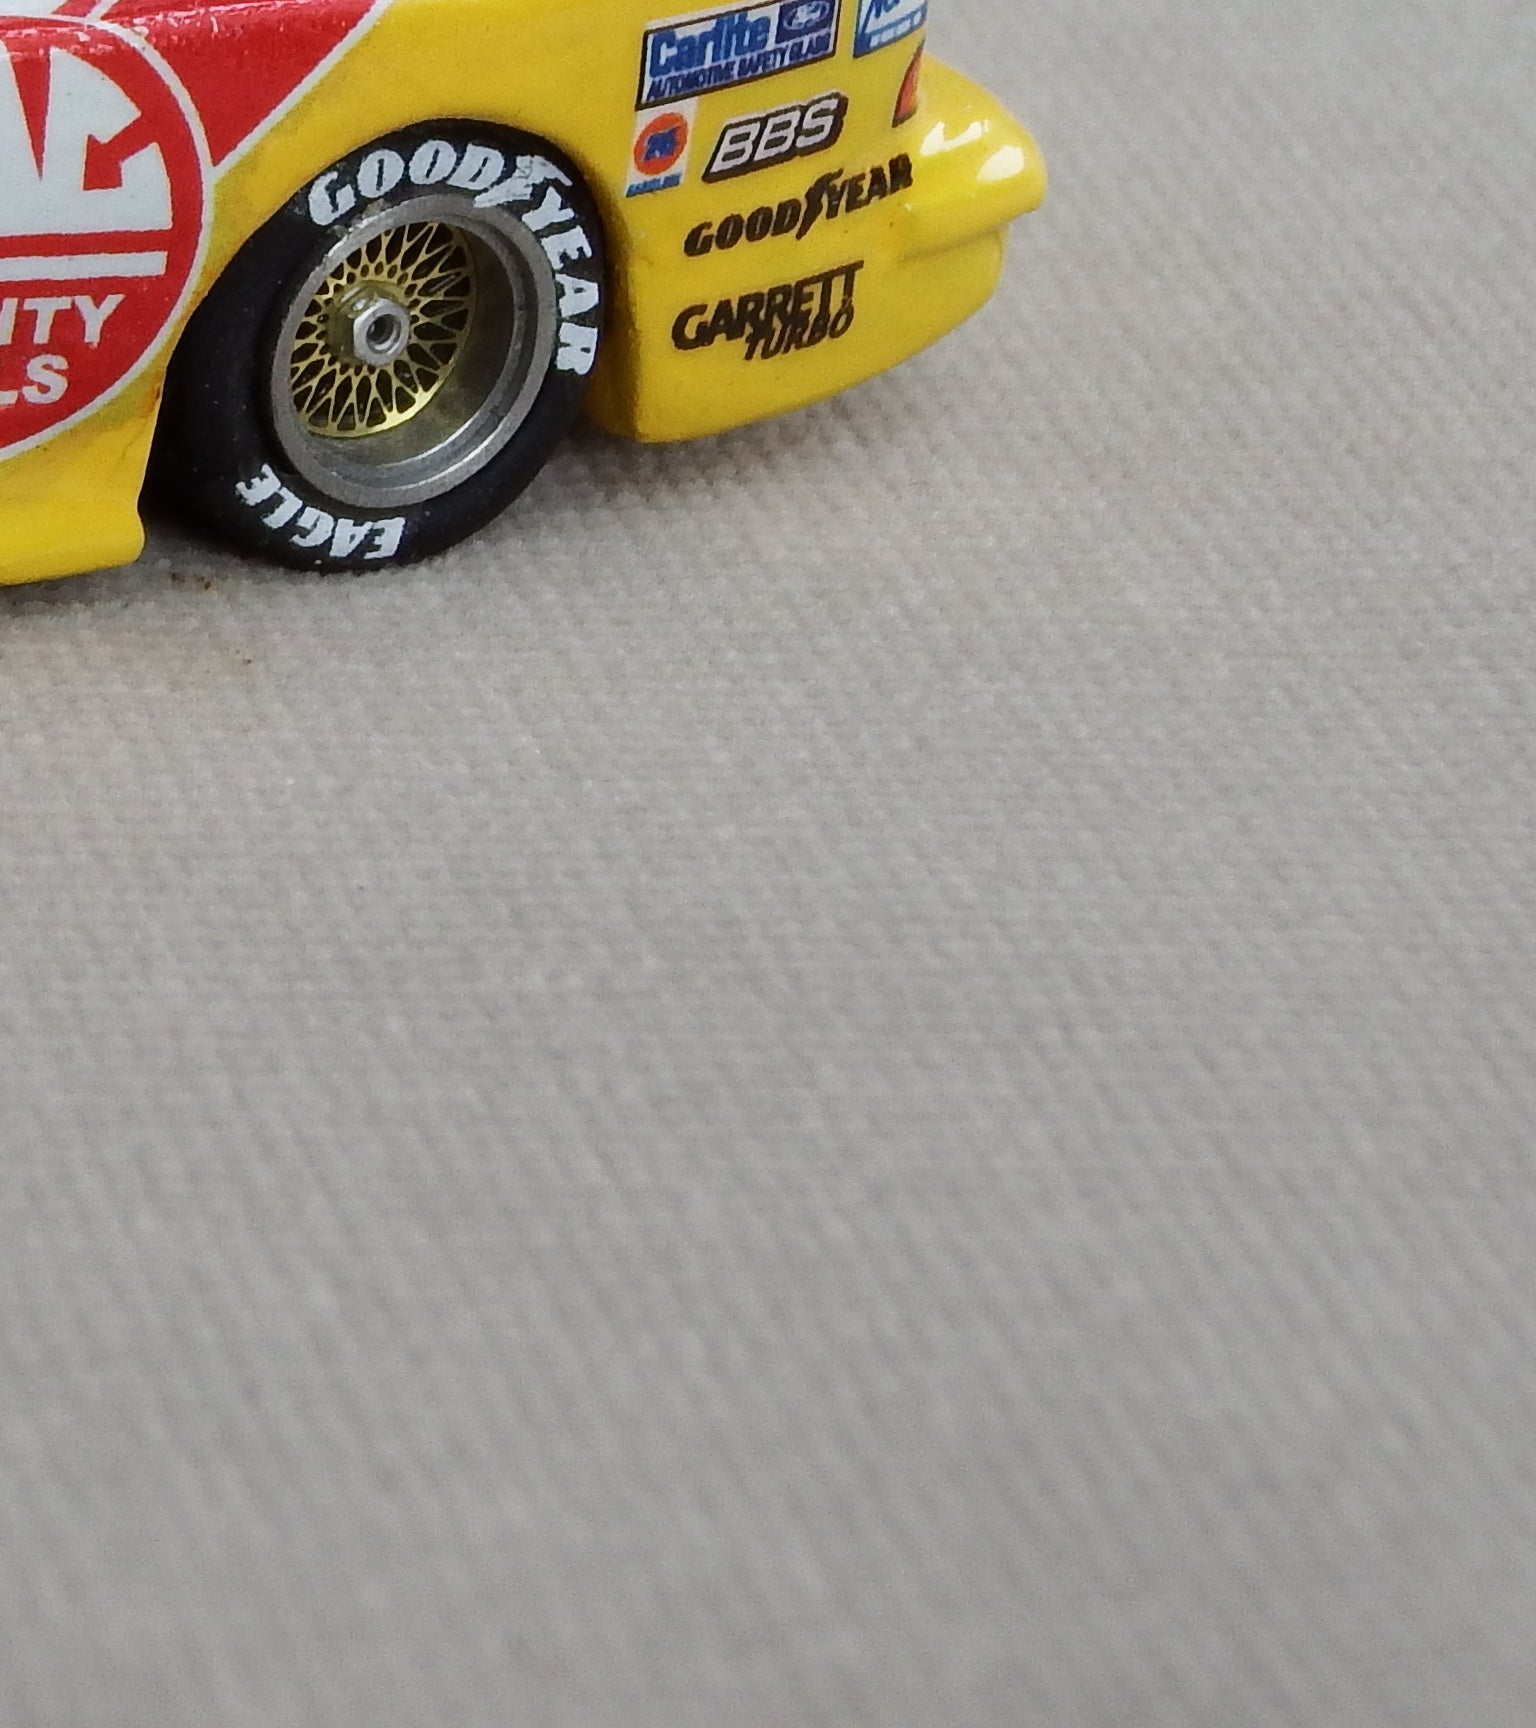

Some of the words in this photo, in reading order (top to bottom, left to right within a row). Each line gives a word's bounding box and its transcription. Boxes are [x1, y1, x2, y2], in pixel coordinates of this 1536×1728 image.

[709, 95, 841, 174] BBS
[683, 152, 913, 257] GOODYEAR
[308, 139, 600, 375] GOODYEAR
[671, 259, 864, 351] GARRETT
[234, 463, 406, 560] EAGLE
